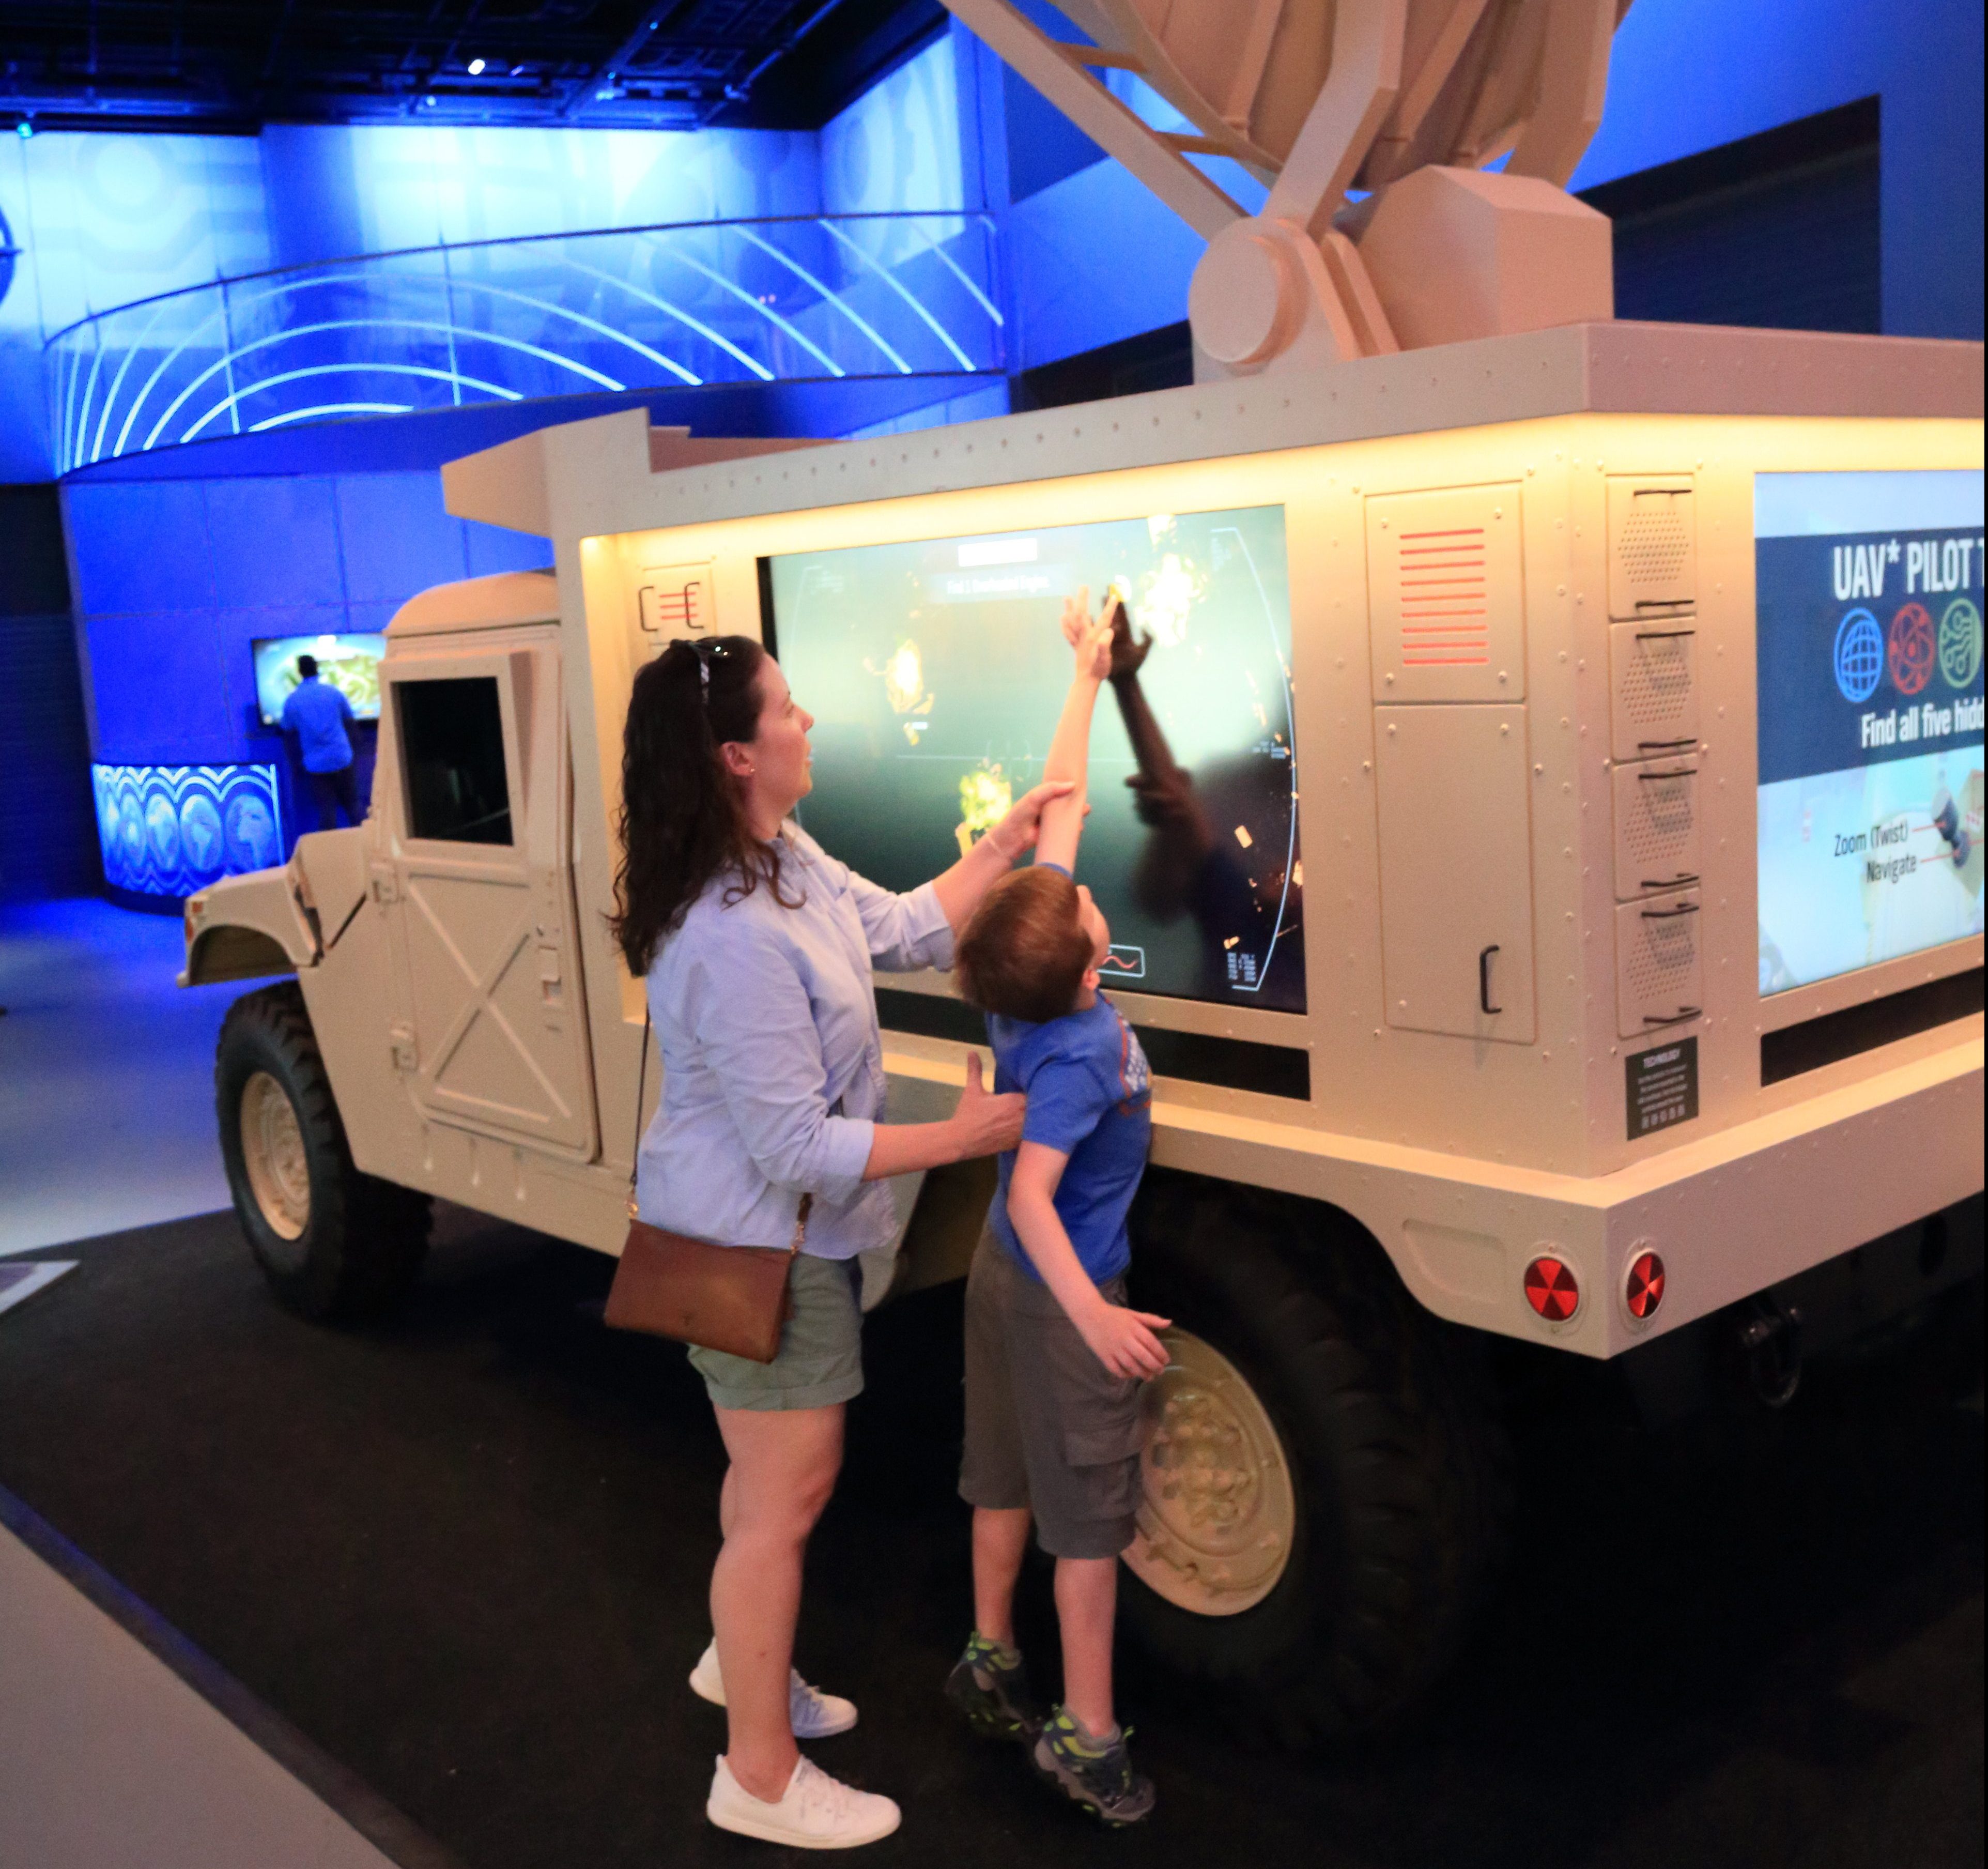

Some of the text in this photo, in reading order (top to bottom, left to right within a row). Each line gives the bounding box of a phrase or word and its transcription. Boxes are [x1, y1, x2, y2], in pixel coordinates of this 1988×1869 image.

[1907, 538, 1973, 594] PILOT
[1861, 709, 1897, 748] Find
[1899, 706, 1919, 742] all
[1922, 702, 1951, 738] five
[1835, 818, 1908, 857] Zoom (Twist)
[1866, 853, 1917, 884] Navigate
